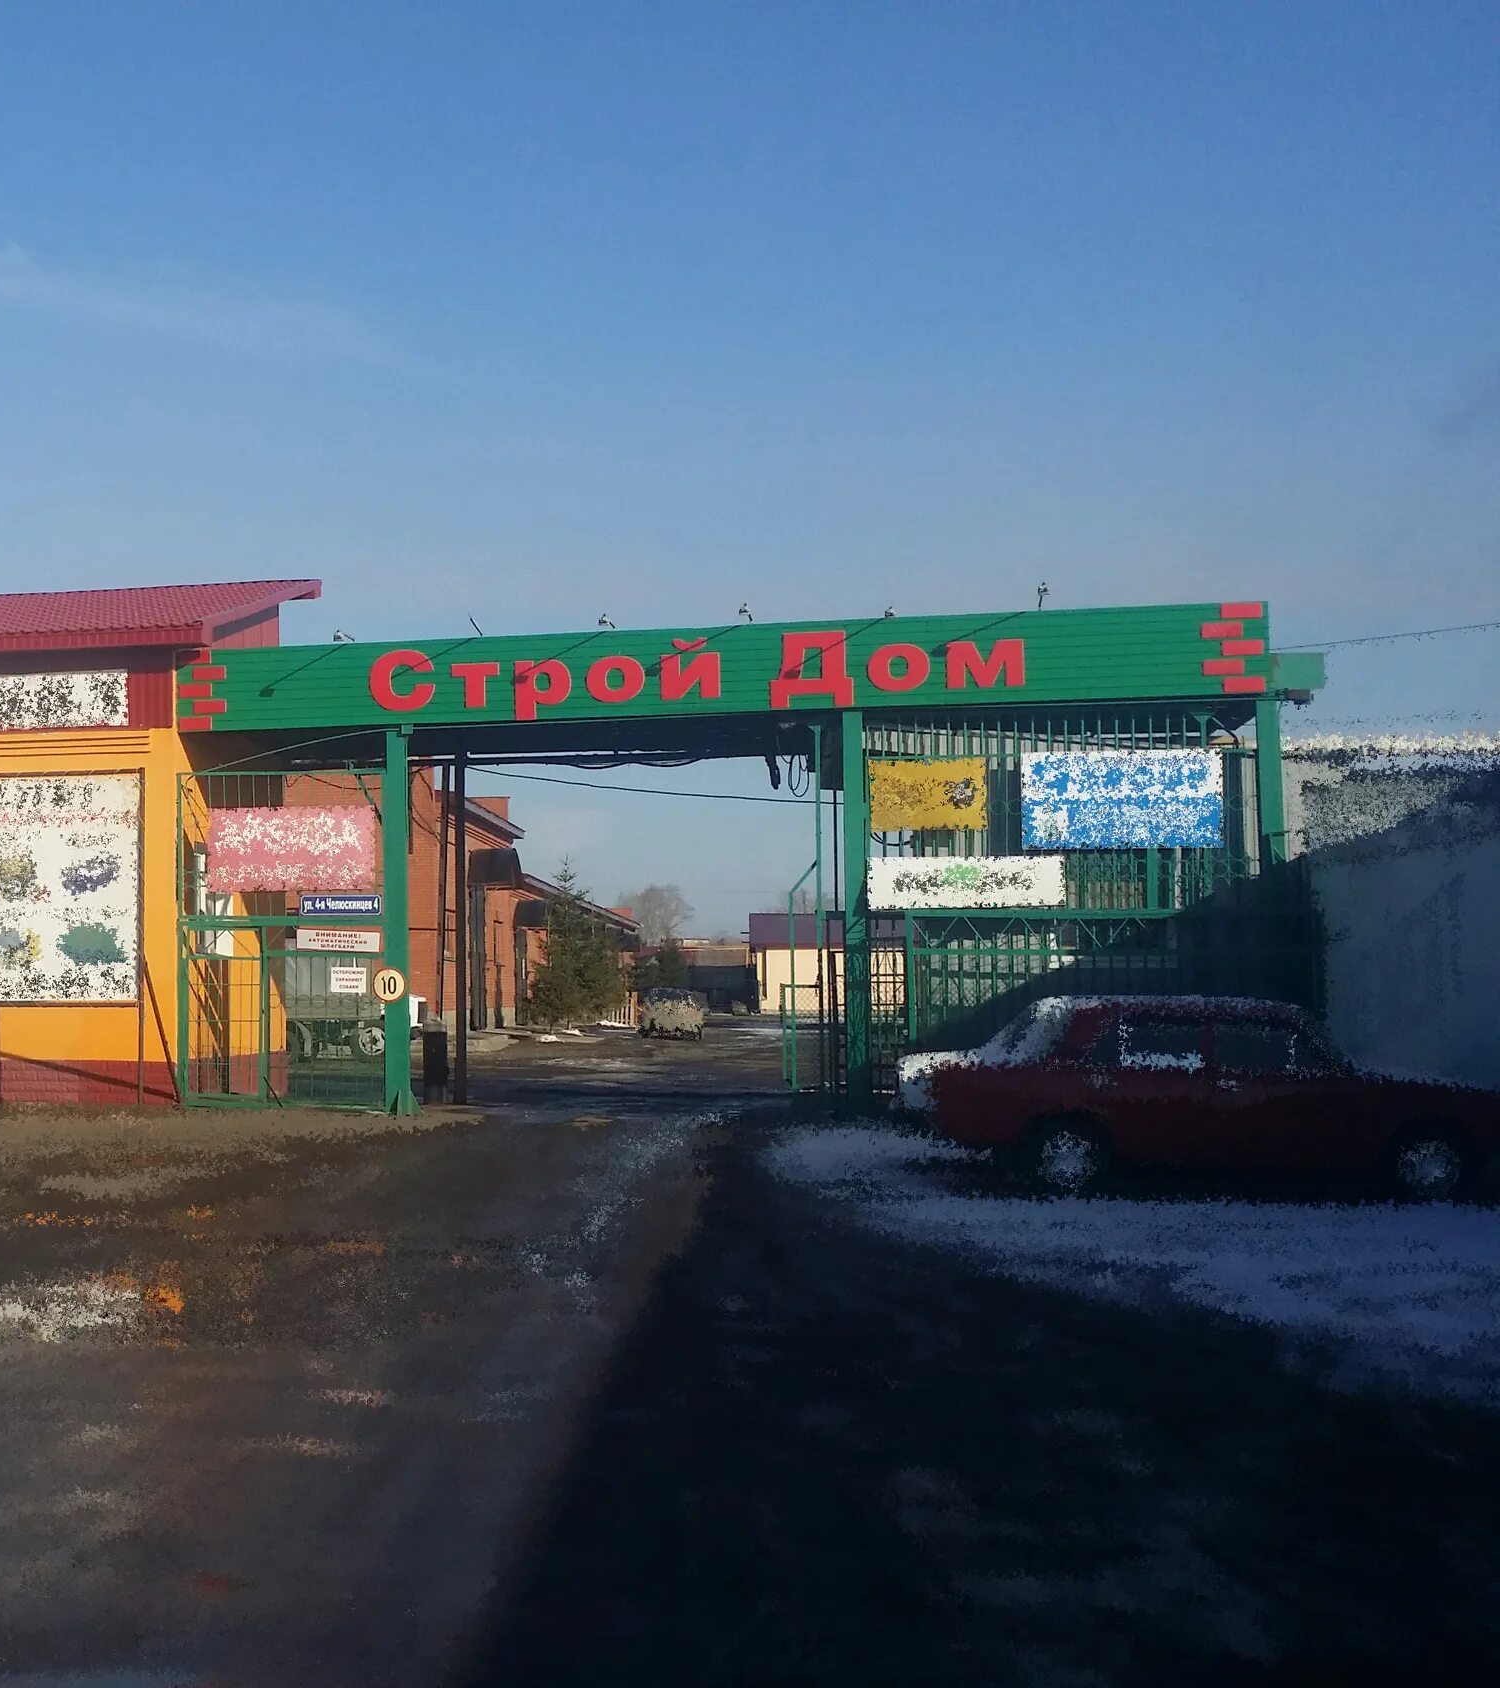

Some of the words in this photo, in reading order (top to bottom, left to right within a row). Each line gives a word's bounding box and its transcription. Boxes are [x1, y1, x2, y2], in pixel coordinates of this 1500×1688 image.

[369, 637, 722, 721] Строй
[769, 630, 1025, 708] Дом
[303, 900, 314, 913] ул.
[315, 898, 325, 910] 4-я
[326, 898, 373, 912] Челюскинцев
[373, 897, 378, 910] 4
[381, 976, 397, 995] 10
